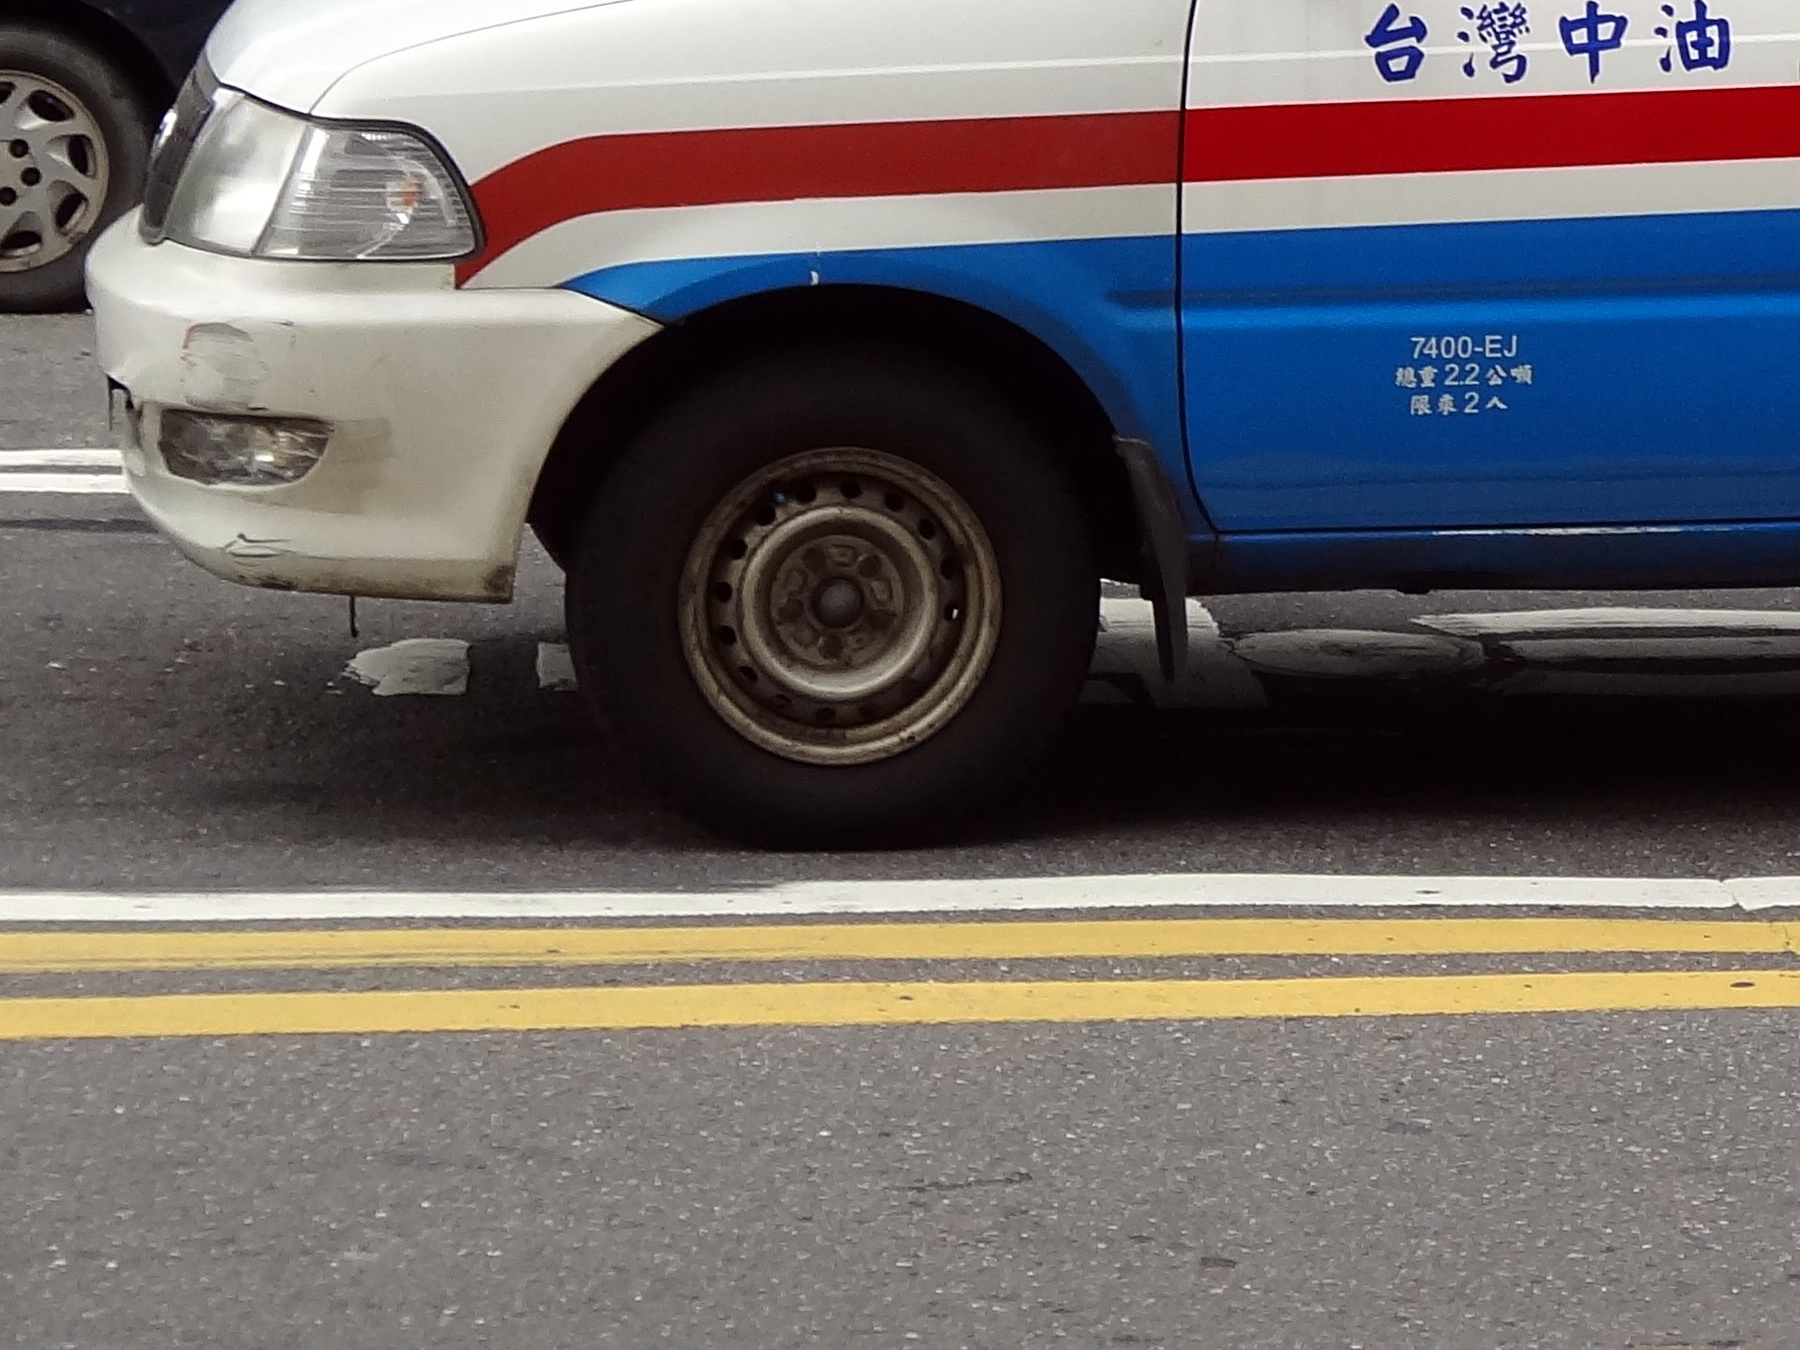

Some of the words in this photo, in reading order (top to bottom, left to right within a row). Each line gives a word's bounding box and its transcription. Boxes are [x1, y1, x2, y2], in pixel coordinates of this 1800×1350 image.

[1365, 0, 1731, 84] 台灣中油
[1409, 335, 1518, 359] 7400-EJ
